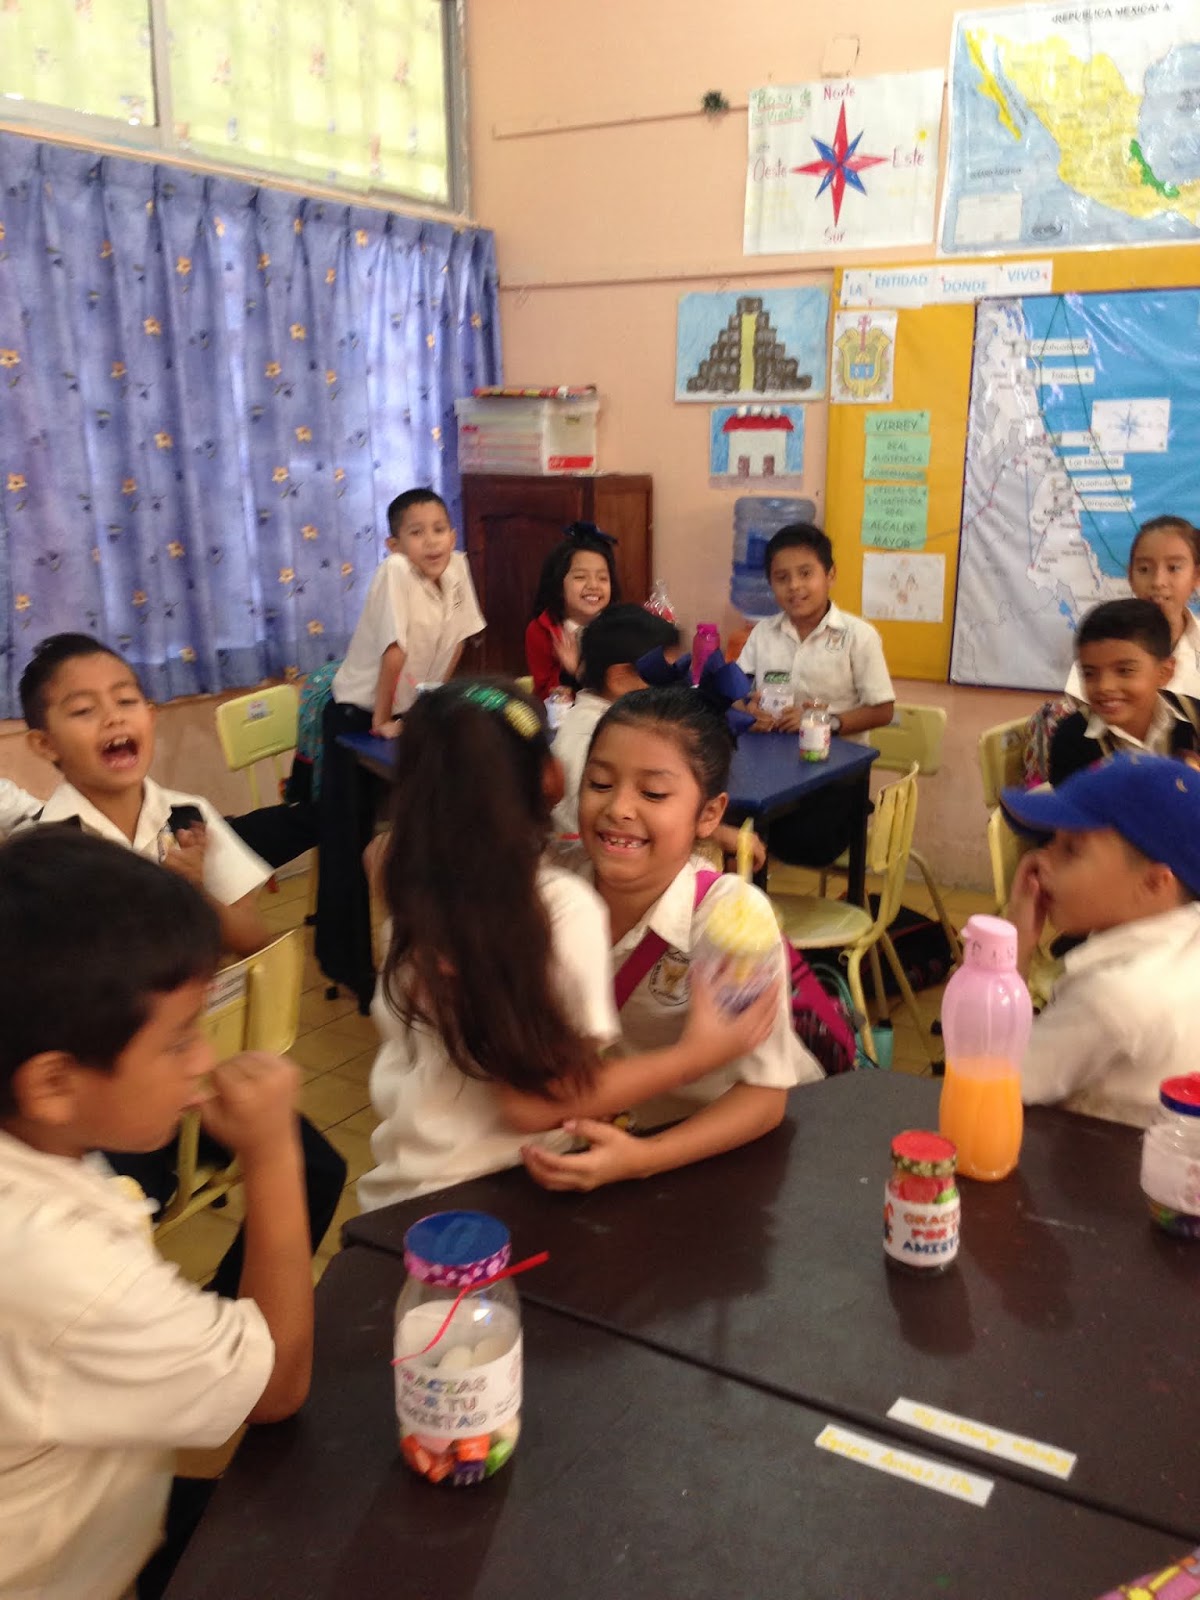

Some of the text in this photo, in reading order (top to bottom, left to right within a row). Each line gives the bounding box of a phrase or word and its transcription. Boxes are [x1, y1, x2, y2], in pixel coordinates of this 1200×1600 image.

[753, 157, 787, 182] Oeste
[824, 228, 845, 243] Sur
[849, 268, 1041, 296] LA ENTIDAD DONDE VIVO
[875, 419, 918, 431] VIRREY
[872, 535, 911, 548] MAYOR
[902, 1238, 958, 1253] AMIST
[444, 1396, 476, 1412] TU
